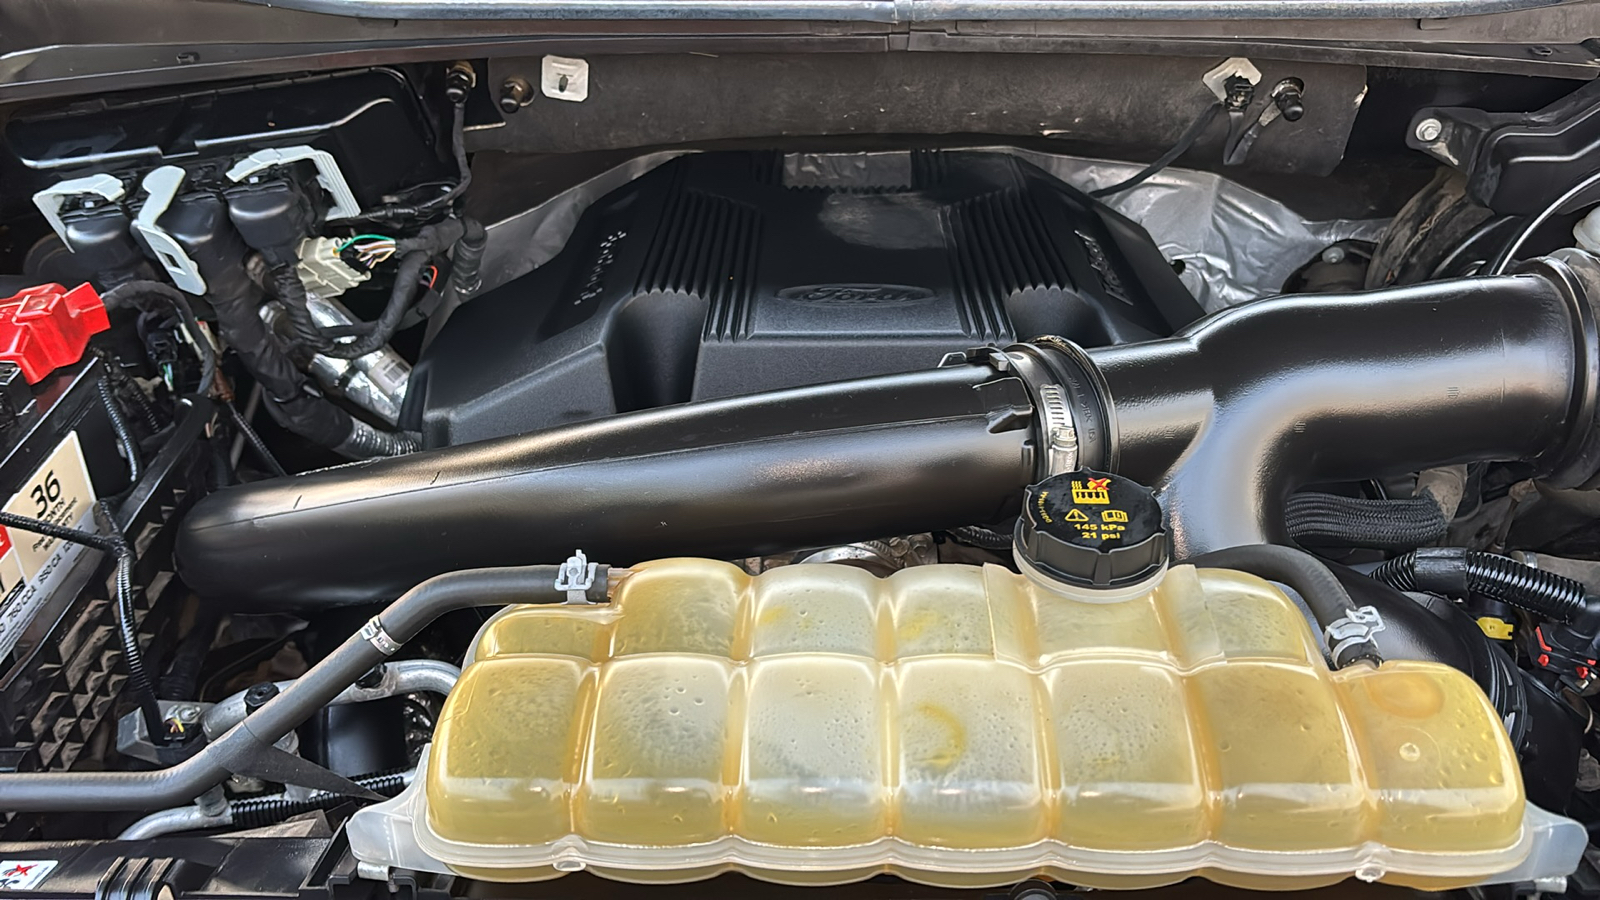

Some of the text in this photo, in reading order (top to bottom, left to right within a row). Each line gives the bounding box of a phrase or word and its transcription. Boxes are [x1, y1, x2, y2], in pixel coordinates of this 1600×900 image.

[30, 470, 60, 519] 36
[1101, 523, 1126, 531] kPa
[1101, 532, 1121, 541] psi
